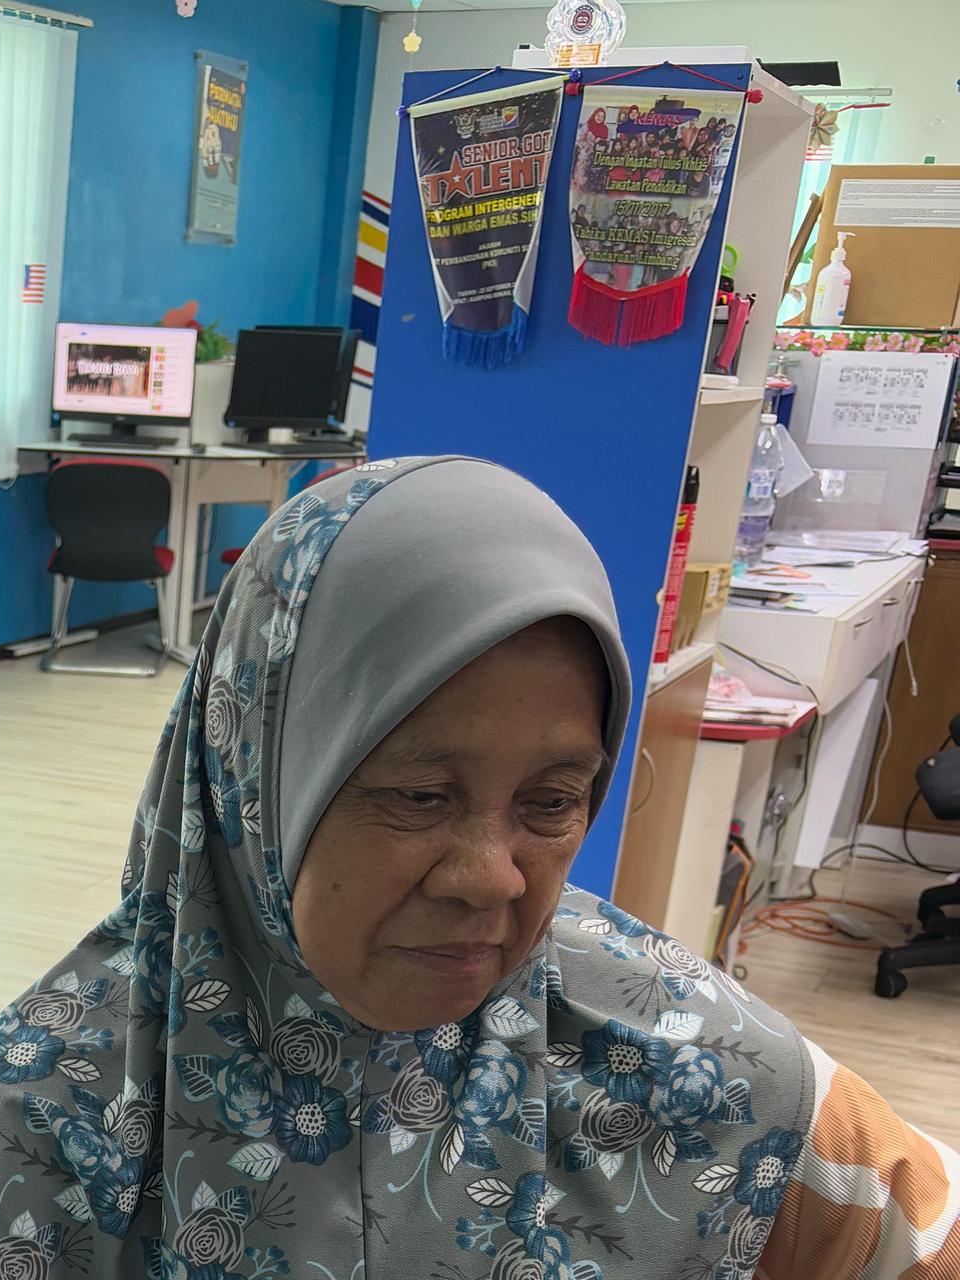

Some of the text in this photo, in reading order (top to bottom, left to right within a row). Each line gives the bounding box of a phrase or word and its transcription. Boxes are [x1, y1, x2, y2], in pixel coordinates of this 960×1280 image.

[463, 129, 552, 166] SENIOR GOT
[422, 151, 551, 206] TALENT
[605, 175, 688, 195] Lawatan Pendidikan
[426, 204, 473, 224] PROGRAM
[452, 218, 489, 237] WARGA
[490, 212, 519, 228] EMAS
